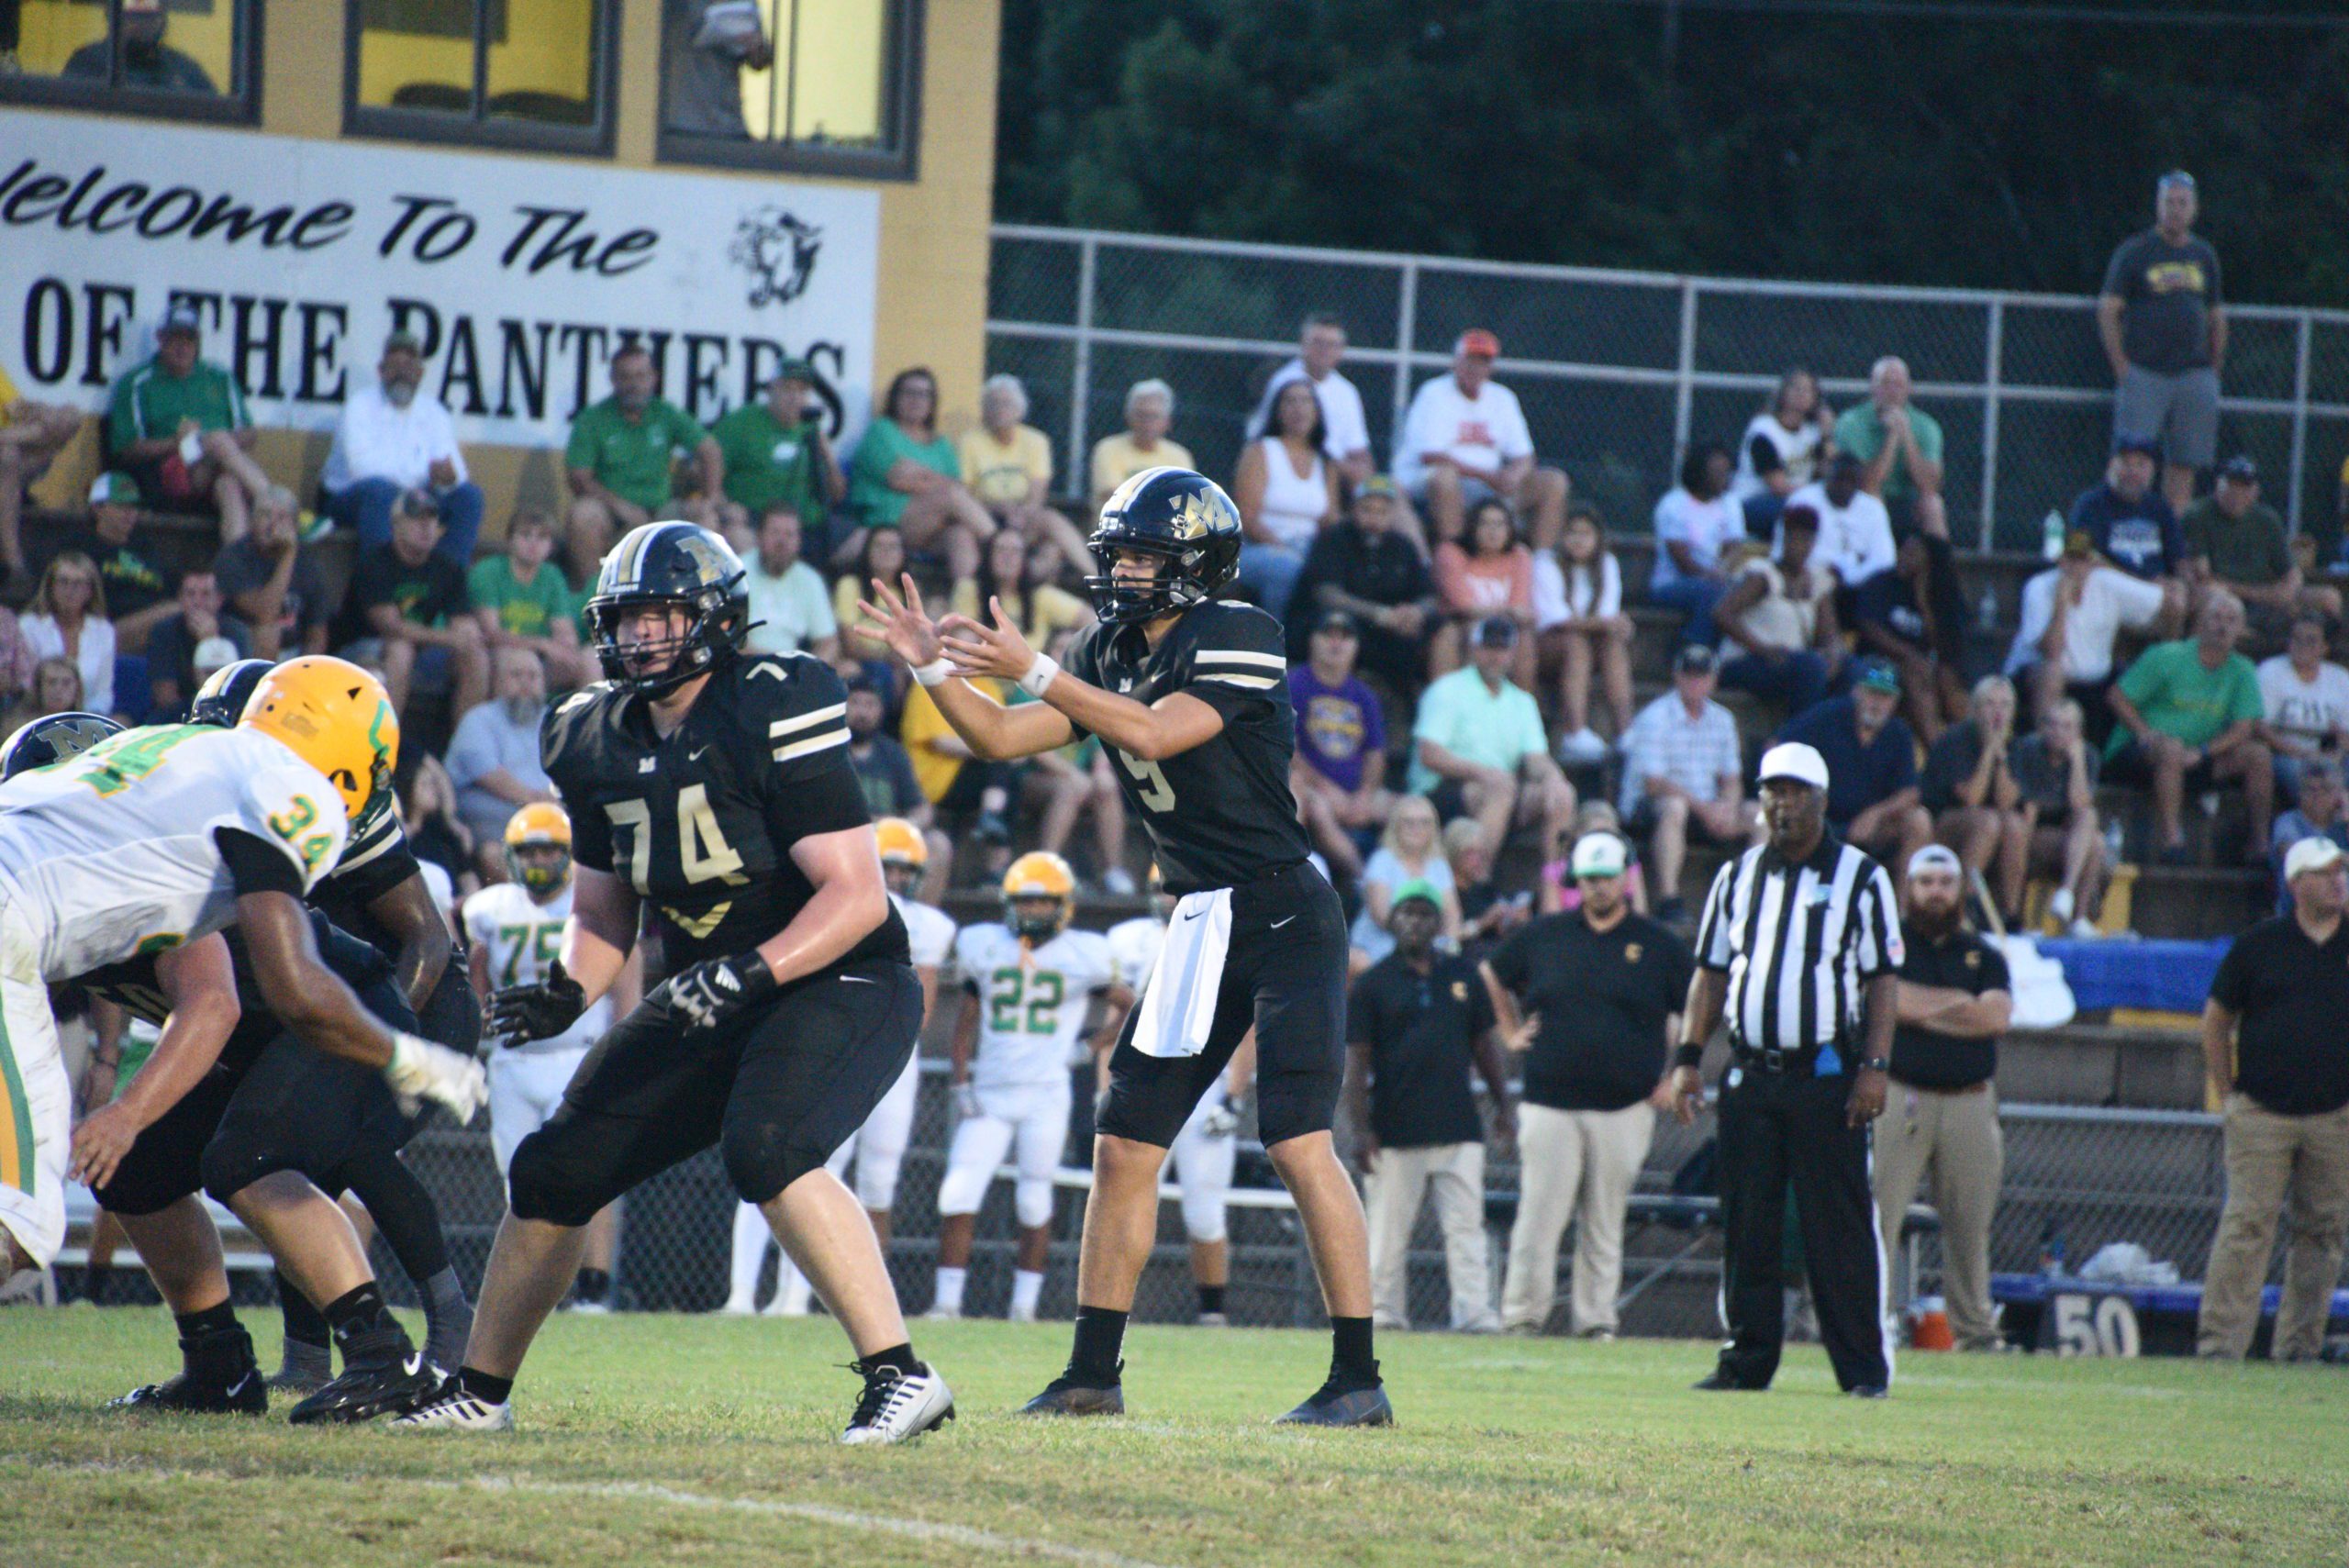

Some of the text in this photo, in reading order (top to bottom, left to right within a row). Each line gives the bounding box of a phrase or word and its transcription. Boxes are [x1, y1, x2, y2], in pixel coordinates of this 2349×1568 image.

[378, 195, 477, 262] To
[500, 206, 660, 276] The
[24, 276, 135, 385] OF
[269, 794, 333, 873] 34
[603, 782, 745, 896] 74
[991, 966, 1063, 1036] 22
[2054, 1294, 2141, 1359] 50
